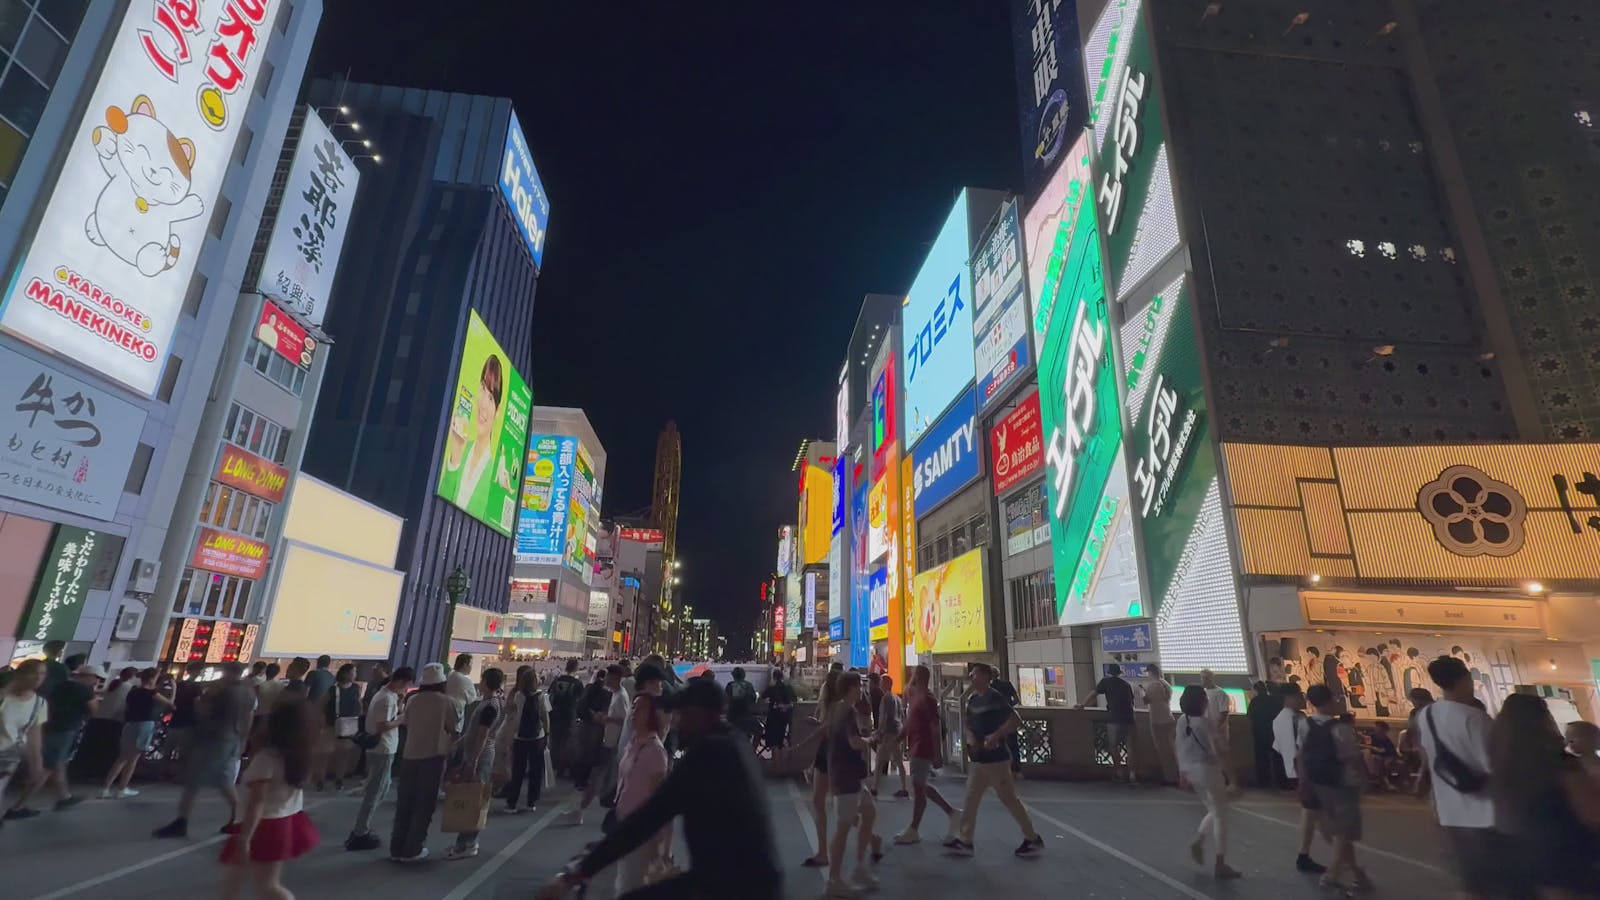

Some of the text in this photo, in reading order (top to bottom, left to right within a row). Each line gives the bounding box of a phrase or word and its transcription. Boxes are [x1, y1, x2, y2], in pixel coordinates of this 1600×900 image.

[1099, 65, 1145, 236] エイブル
[504, 149, 544, 253] Haier
[27, 280, 156, 361] MANEKINEKO
[68, 270, 143, 326] KARAOKE
[908, 272, 964, 385] プロミス
[15, 372, 102, 447] 牛かつ
[1046, 297, 1107, 520] エイブル
[1135, 373, 1177, 519] エイブル
[6, 432, 73, 469] もと村
[223, 454, 255, 484] LONG
[924, 415, 975, 488] SAMTY
[62, 531, 96, 605] こだわりたい
[204, 534, 235, 551] LONG
[34, 542, 79, 640] 美味しさがある
[353, 614, 386, 633] IQOS
